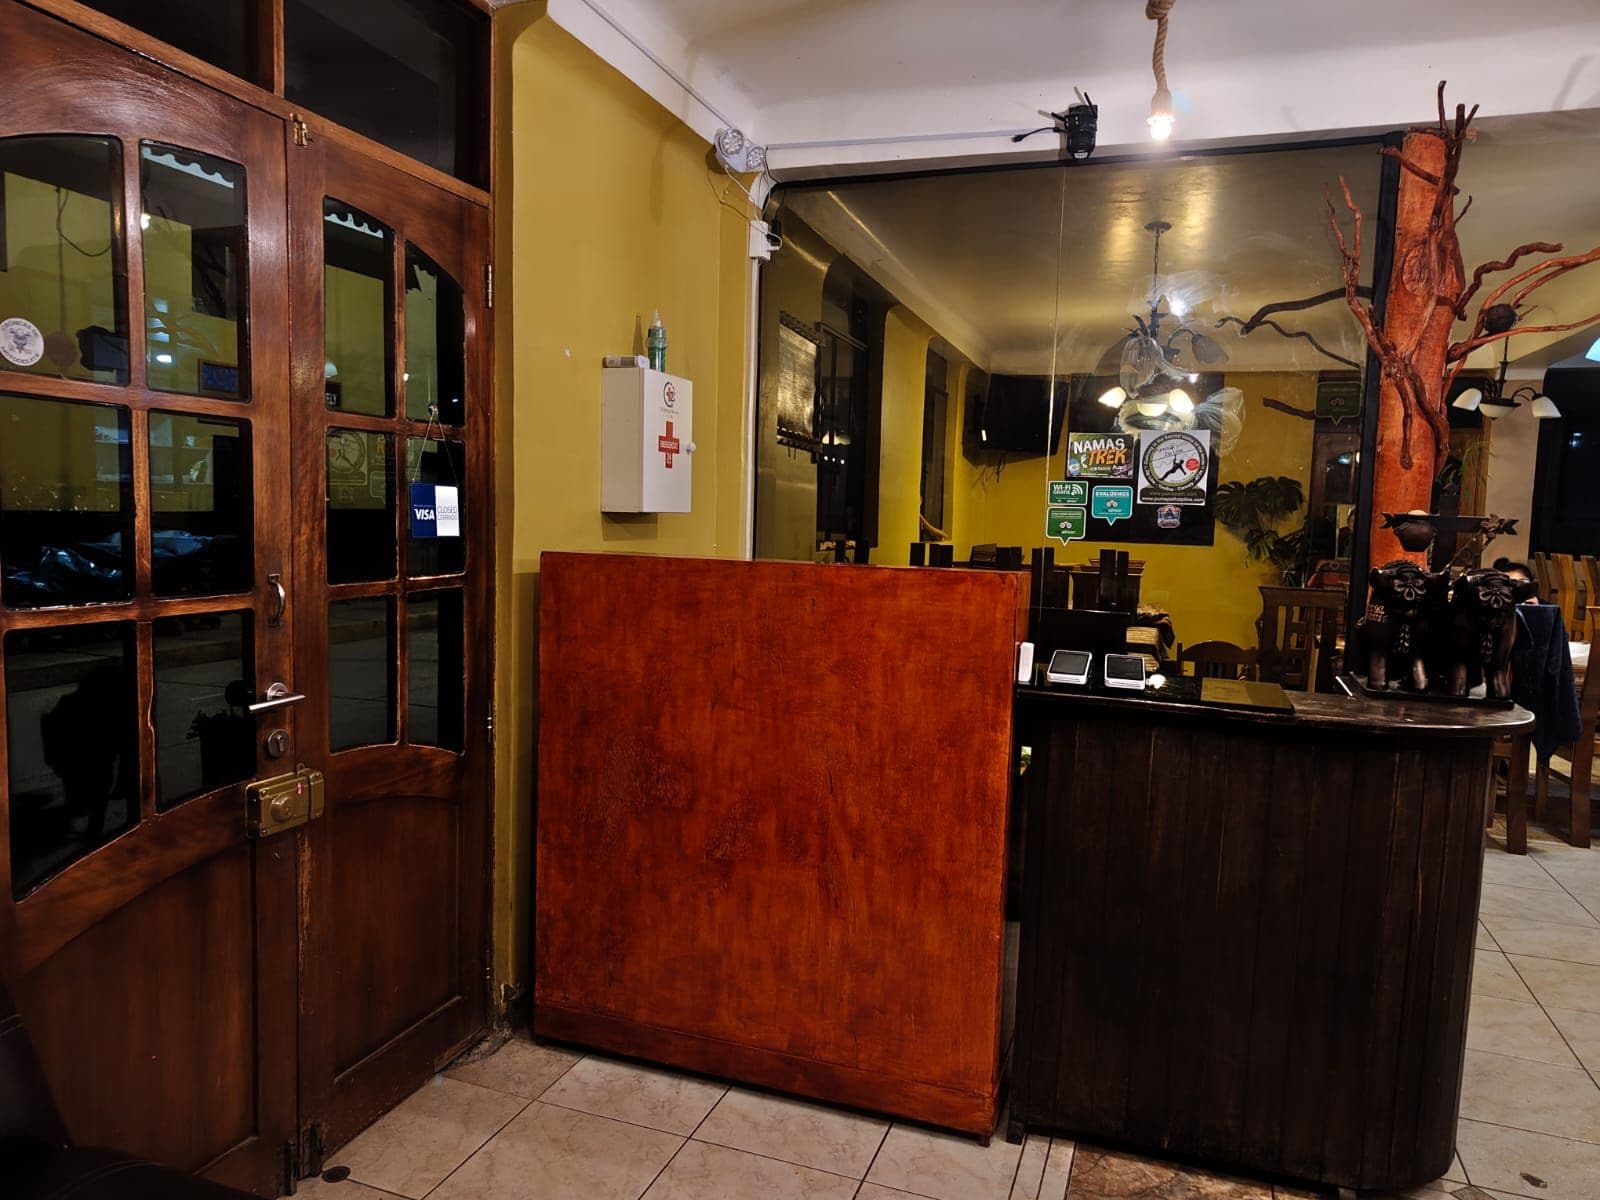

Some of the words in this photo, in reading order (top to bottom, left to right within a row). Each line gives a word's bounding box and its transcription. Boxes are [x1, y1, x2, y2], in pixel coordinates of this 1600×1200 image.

[1073, 438, 1125, 454] NAMAS
[1088, 448, 1127, 466] TREK
[413, 508, 435, 520] VISA
[437, 505, 457, 514] CLOSED
